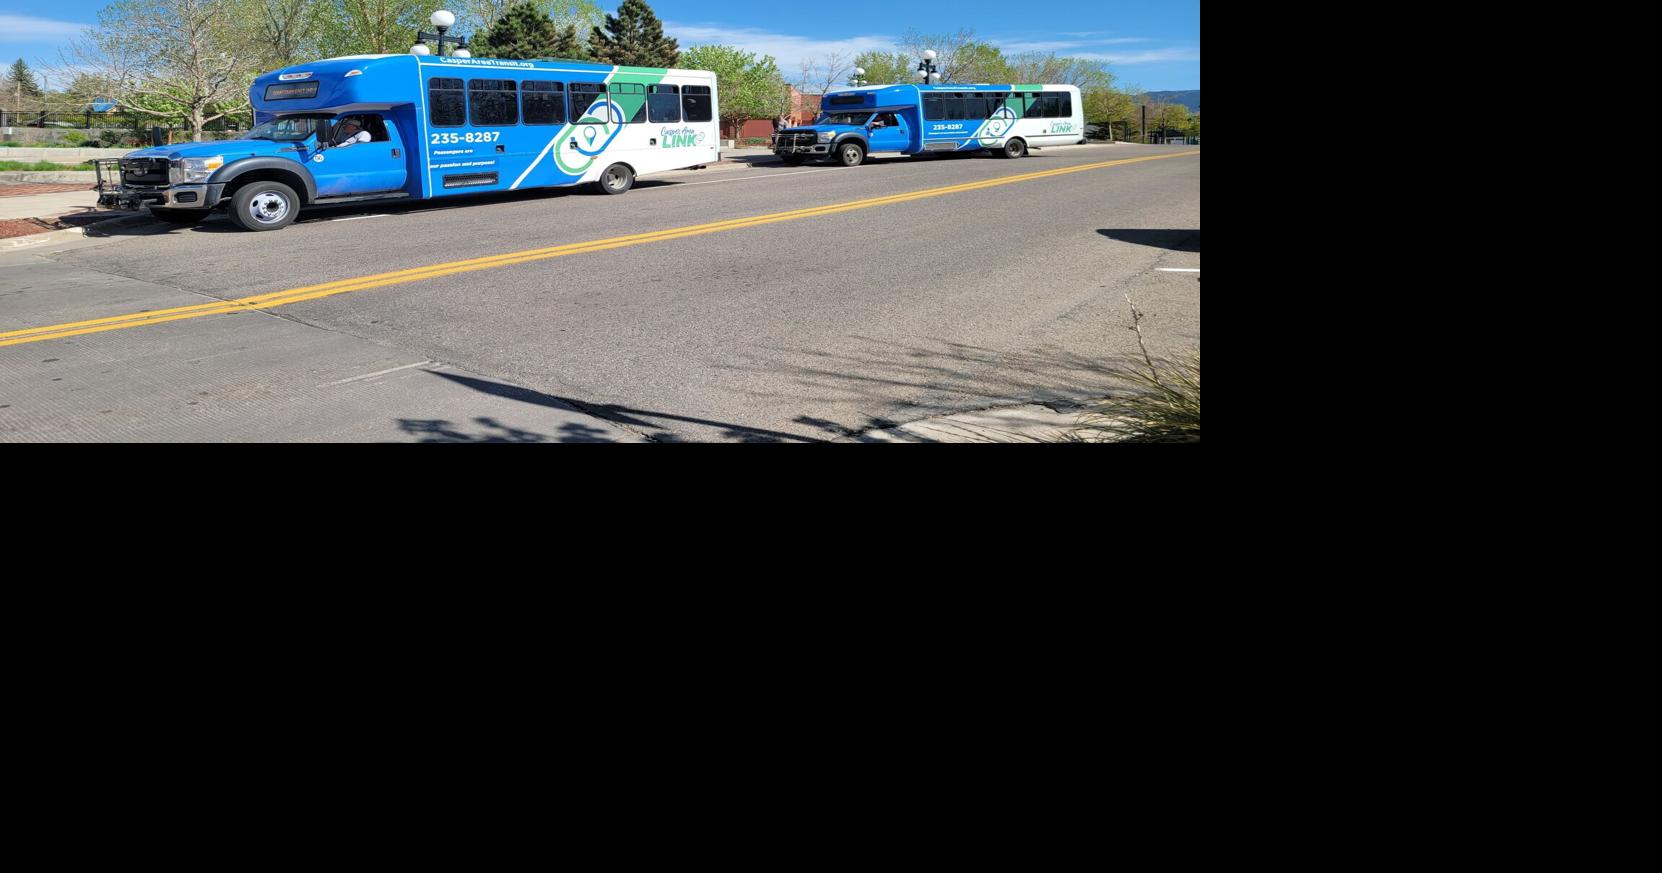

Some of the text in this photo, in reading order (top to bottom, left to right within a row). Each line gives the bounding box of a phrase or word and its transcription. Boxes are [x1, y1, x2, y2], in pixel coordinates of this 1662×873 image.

[1051, 125, 1072, 133] LINK
[431, 131, 500, 145] 235-8287
[662, 134, 697, 148] LINK
